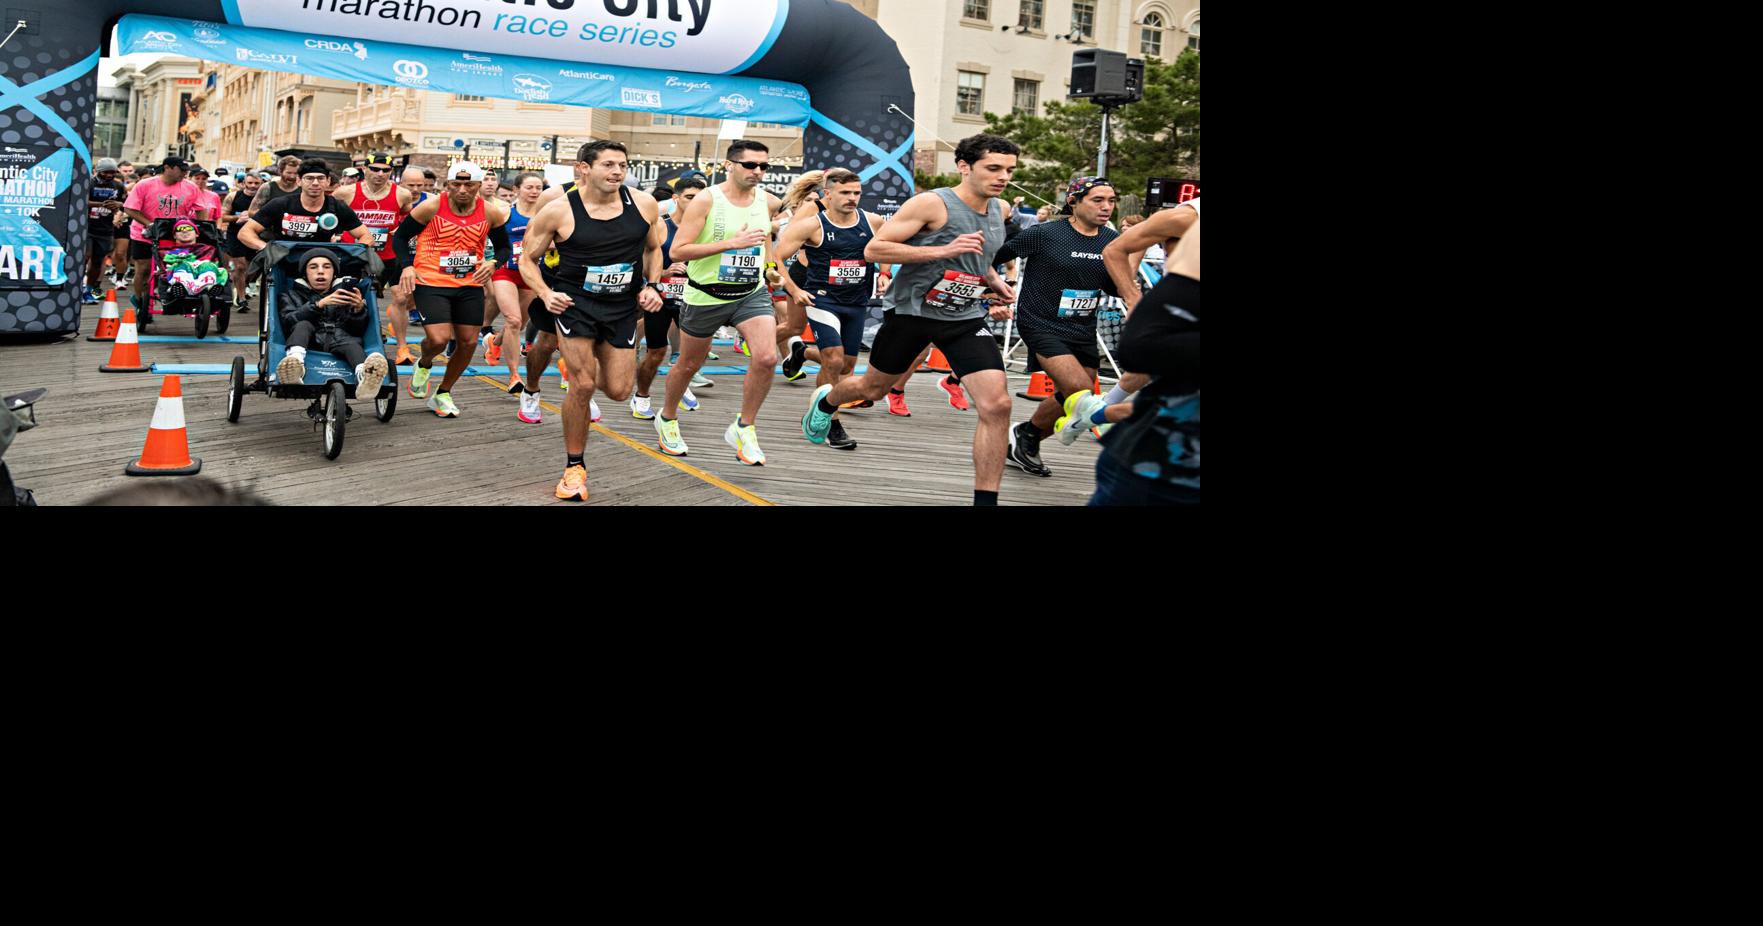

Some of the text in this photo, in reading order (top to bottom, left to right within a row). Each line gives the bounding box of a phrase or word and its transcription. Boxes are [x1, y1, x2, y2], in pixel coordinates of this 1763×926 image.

[493, 12, 568, 38] race
[579, 21, 677, 48] series
[304, 39, 353, 53] CRDA
[559, 69, 615, 82] AtlantiCare
[0, 165, 58, 183] ntic City
[3, 196, 54, 205] MARATHON
[16, 207, 40, 217] 10K
[288, 222, 312, 231] 3997
[0, 245, 64, 280] ART
[447, 257, 471, 266] 3054
[731, 255, 756, 267] 1190
[837, 267, 860, 277] 3556
[597, 273, 625, 285] 1457
[666, 283, 685, 294] 330
[945, 282, 978, 297] 3555
[1071, 298, 1094, 308] 1727
